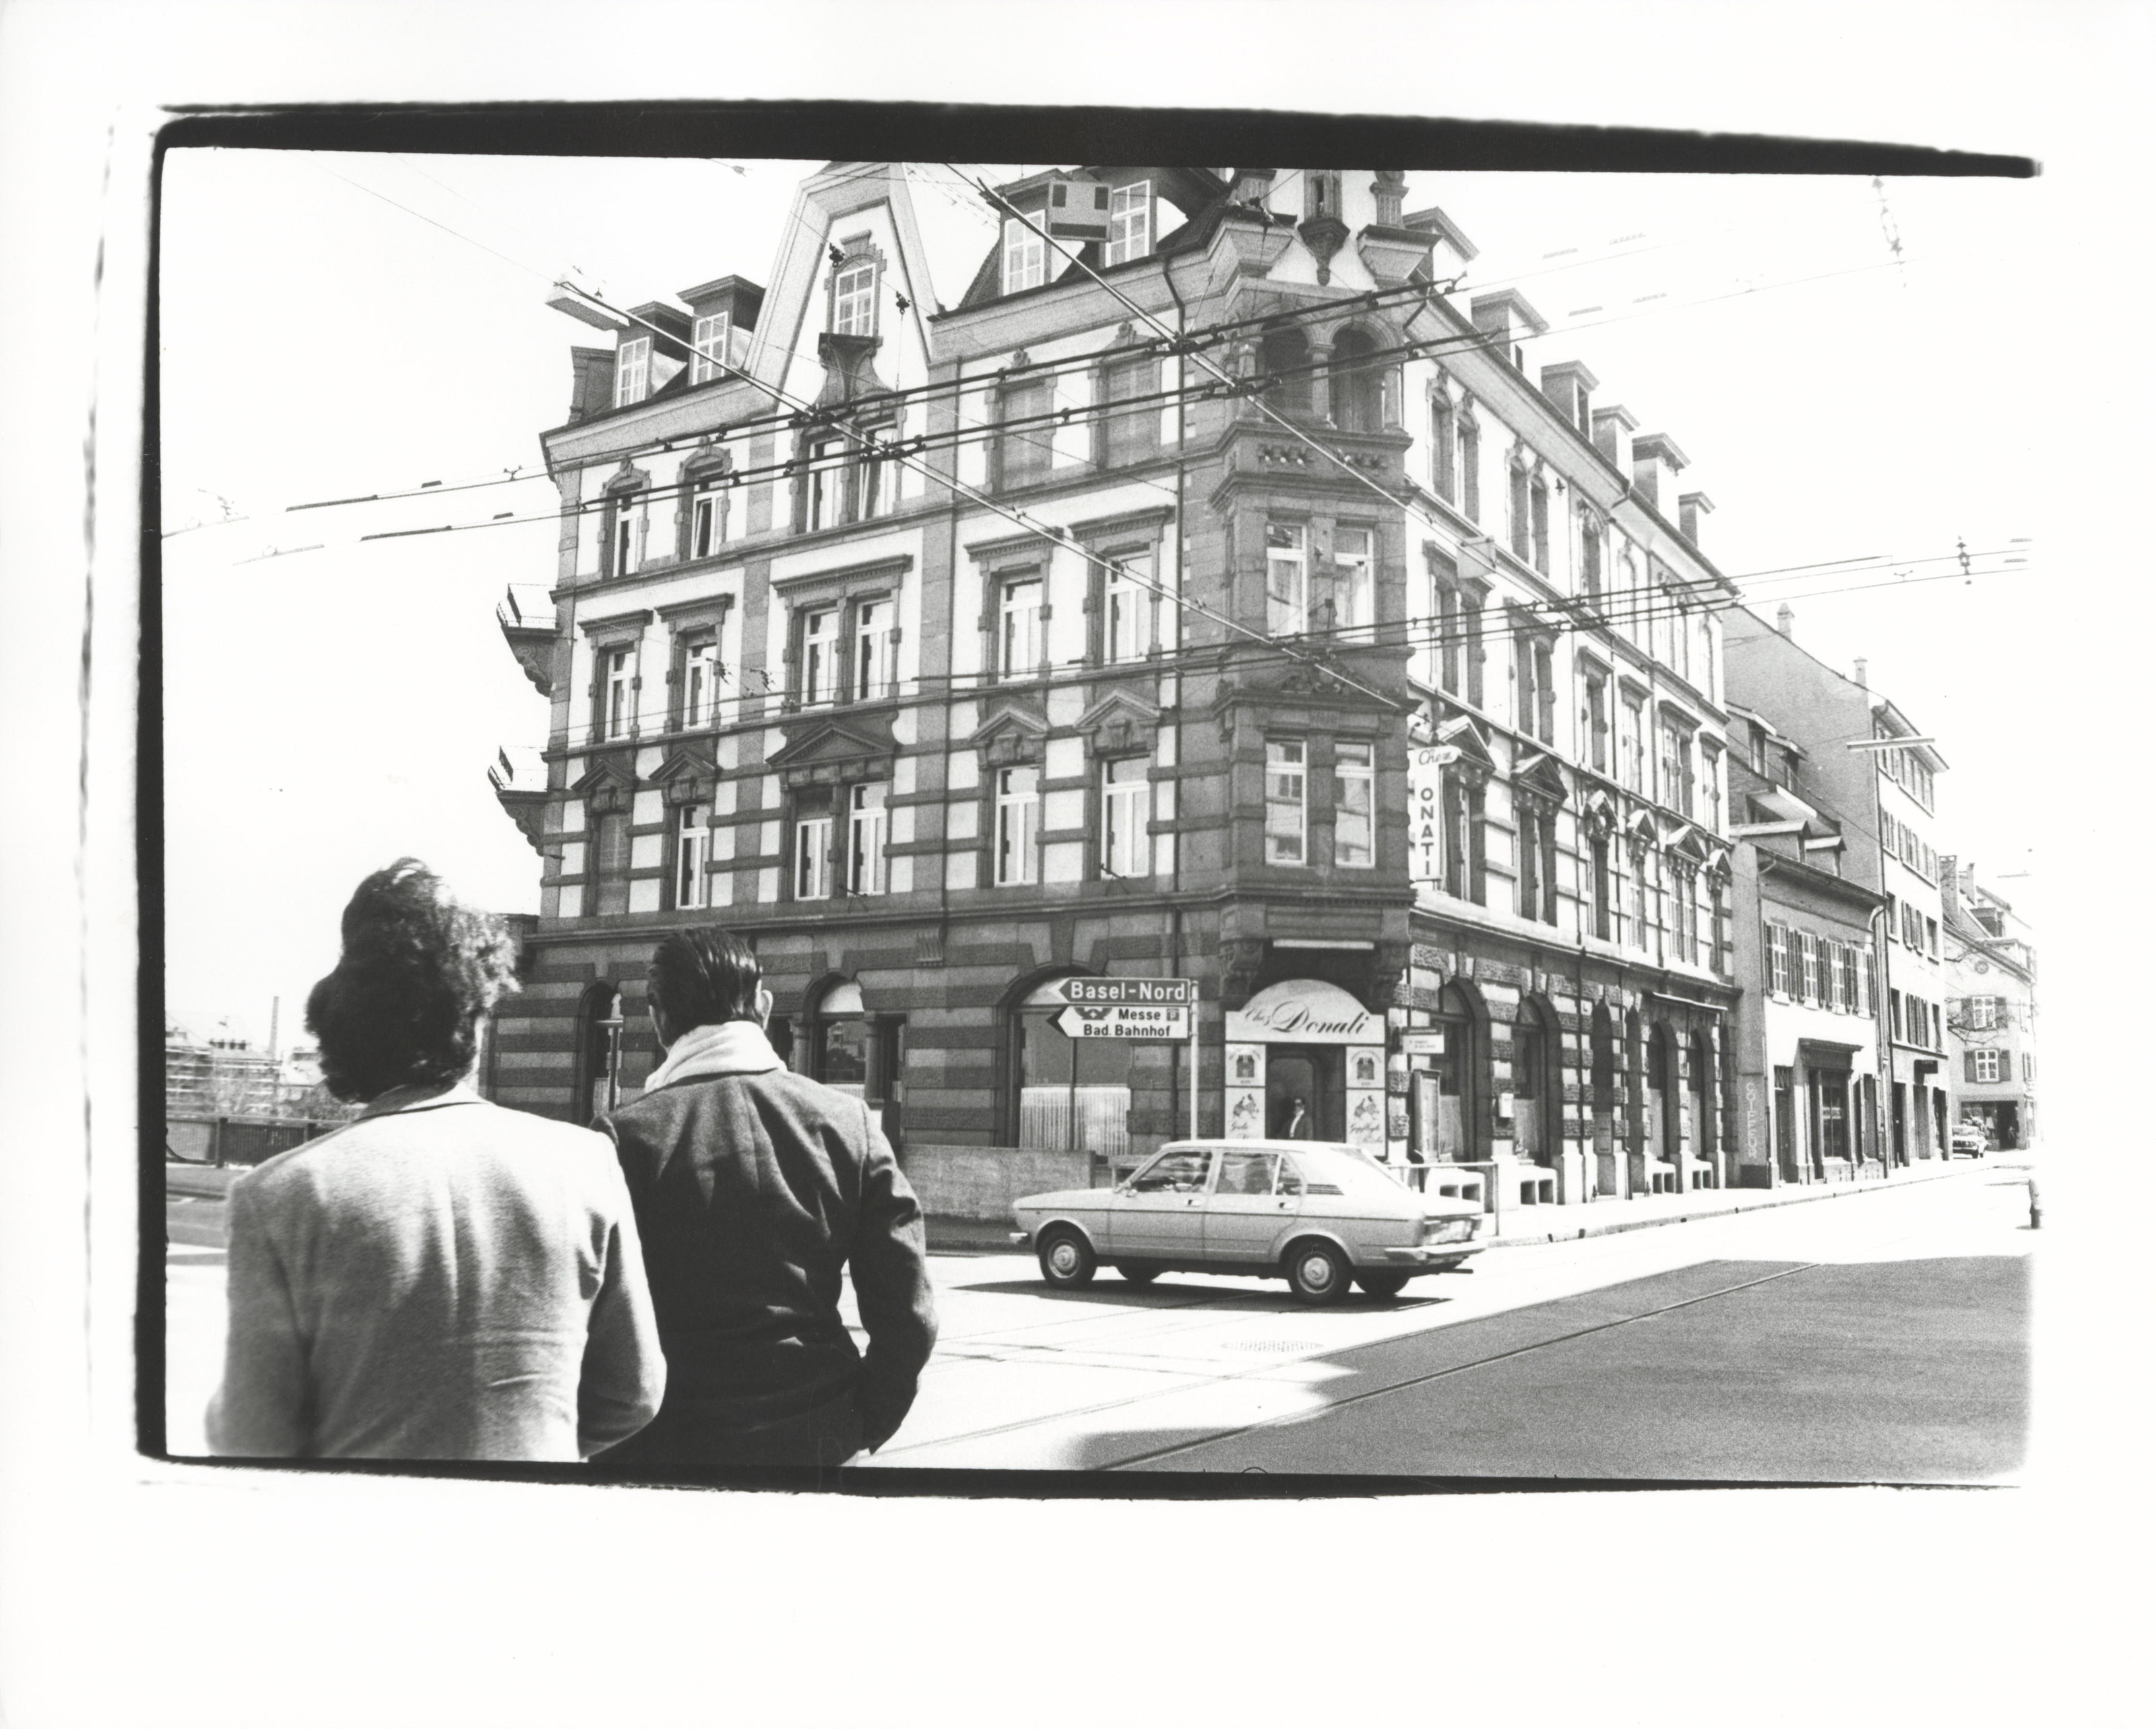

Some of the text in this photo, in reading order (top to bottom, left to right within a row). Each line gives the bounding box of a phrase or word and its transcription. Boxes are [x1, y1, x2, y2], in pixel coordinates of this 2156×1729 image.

[1418, 748, 1453, 765] Chez
[1071, 982, 1185, 1001] Basel-Nord
[1118, 1008, 1161, 1020] Messe
[1244, 1007, 1272, 1026] Chez
[1083, 1024, 1170, 1036] Bad. Bahnhof
[1745, 1082, 1758, 1158] COIFFEUR
